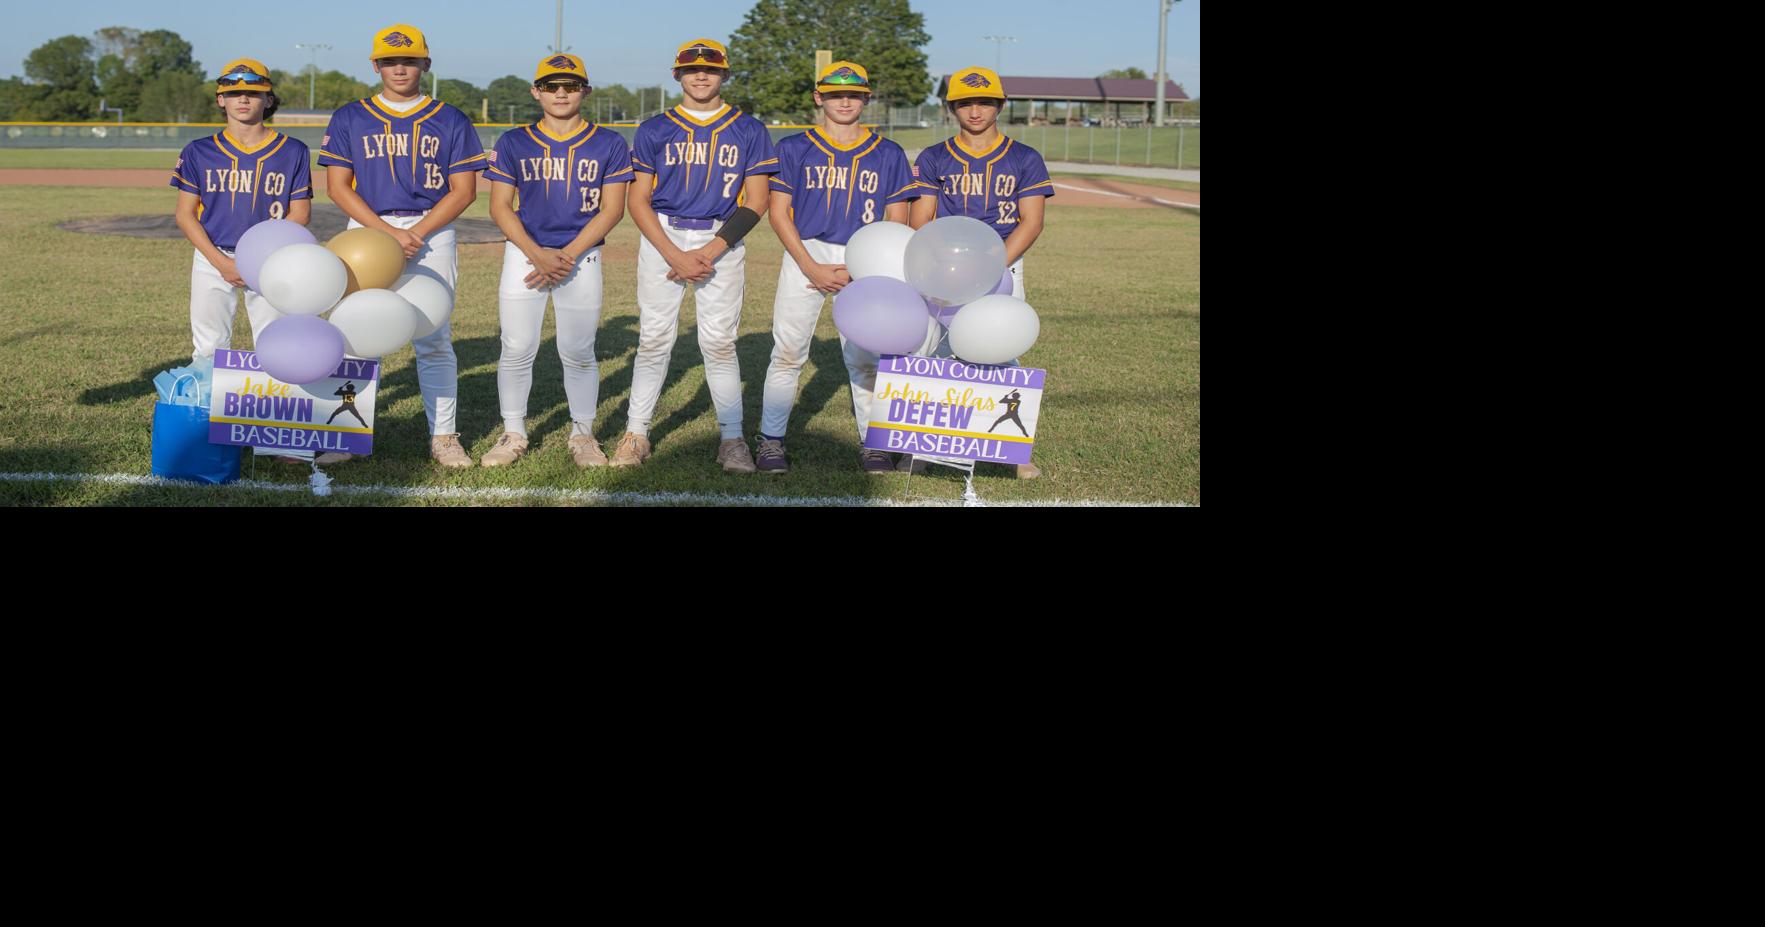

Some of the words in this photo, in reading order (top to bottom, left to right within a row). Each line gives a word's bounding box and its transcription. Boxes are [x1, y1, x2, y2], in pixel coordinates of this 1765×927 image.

[362, 133, 409, 159] LYON
[420, 134, 440, 159] CO
[664, 141, 708, 166] LYON
[718, 143, 738, 168] CO
[206, 168, 253, 193] LYON
[264, 171, 286, 196] CO
[423, 162, 445, 190] 15
[520, 157, 566, 181] LYON
[577, 158, 599, 182] CO
[805, 166, 849, 190] LYON
[858, 169, 879, 194] CO
[722, 172, 739, 198] 7
[994, 173, 1016, 197] CO
[269, 201, 284, 220] 9
[580, 186, 601, 213] 13
[861, 198, 875, 224] 8
[996, 200, 1017, 225] 12
[226, 351, 261, 369] LYO
[890, 356, 945, 377] LYON
[950, 362, 1035, 386] COUNTY
[237, 376, 292, 399] Jake
[877, 382, 929, 404] John
[941, 388, 996, 411] Silas
[224, 392, 313, 422] BROWN
[888, 397, 974, 429] DEFEW
[1010, 402, 1018, 411] 7
[230, 424, 350, 451] BASEBALL
[887, 430, 1007, 460] BASEBALL
